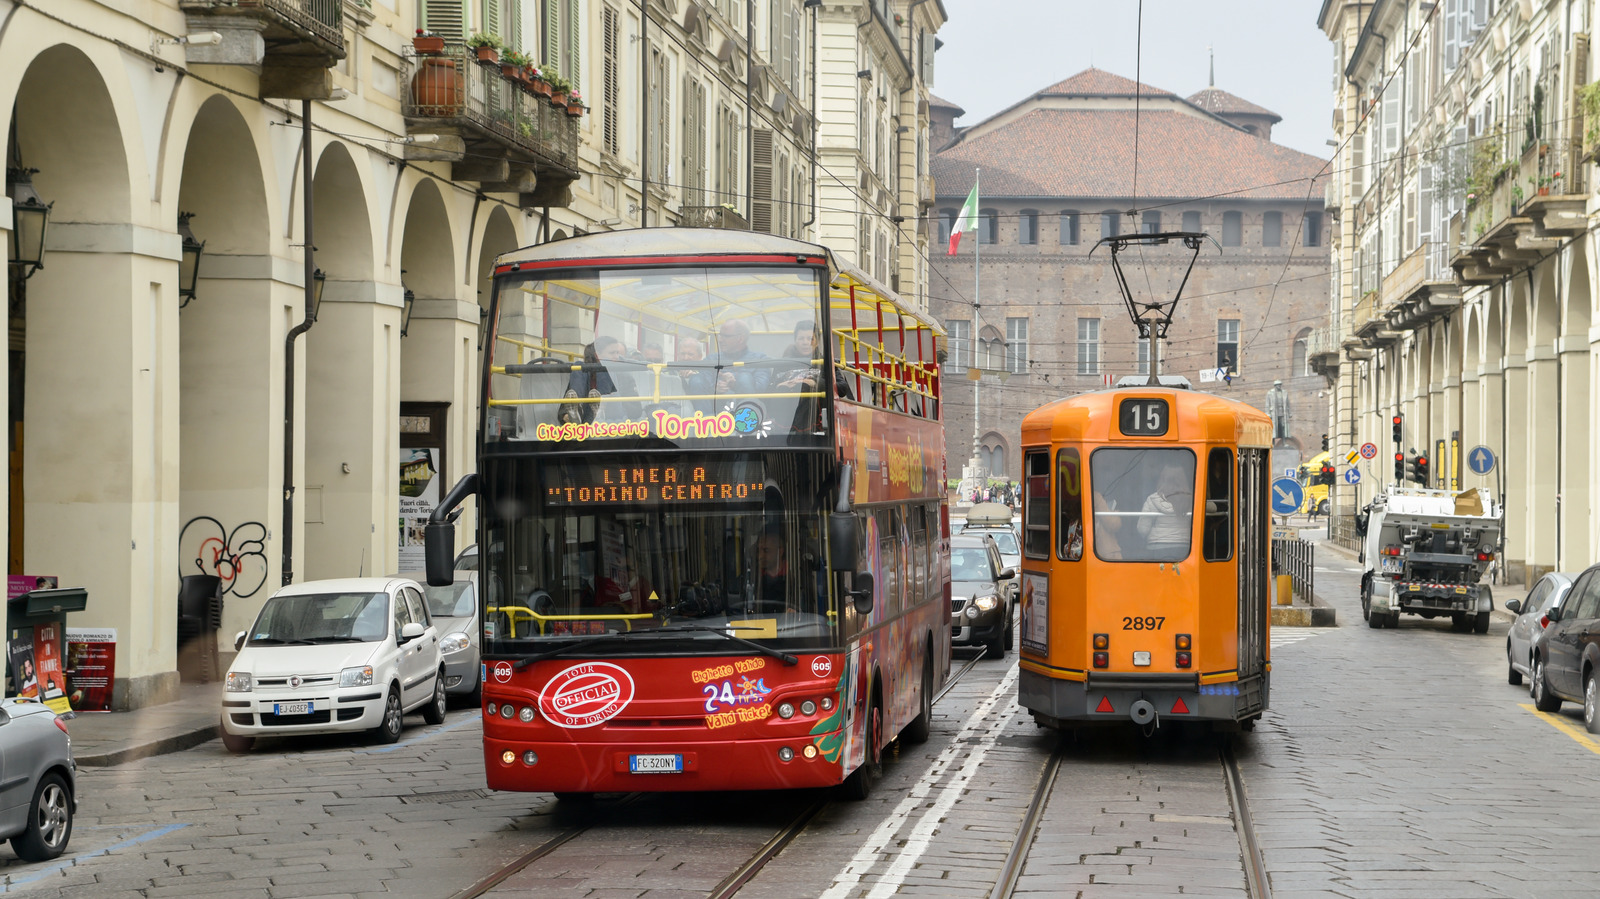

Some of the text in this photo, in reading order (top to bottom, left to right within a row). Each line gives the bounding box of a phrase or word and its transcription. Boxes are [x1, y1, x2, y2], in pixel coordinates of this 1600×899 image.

[537, 409, 735, 441] CitySightseeing Torino
[1131, 404, 1160, 430] 15
[604, 467, 705, 484] LINEA A
[549, 483, 763, 502] "TORINO CENTRO"
[1122, 616, 1166, 631] 2897
[495, 668, 511, 676] 605
[563, 665, 595, 680] TOUR
[692, 658, 765, 684] Biglietto Valido
[813, 662, 830, 671] 605
[557, 683, 618, 707] OFFICIAL
[703, 680, 736, 714] 24
[565, 704, 618, 725] OF TORINO
[706, 703, 773, 730] Valid Ticket
